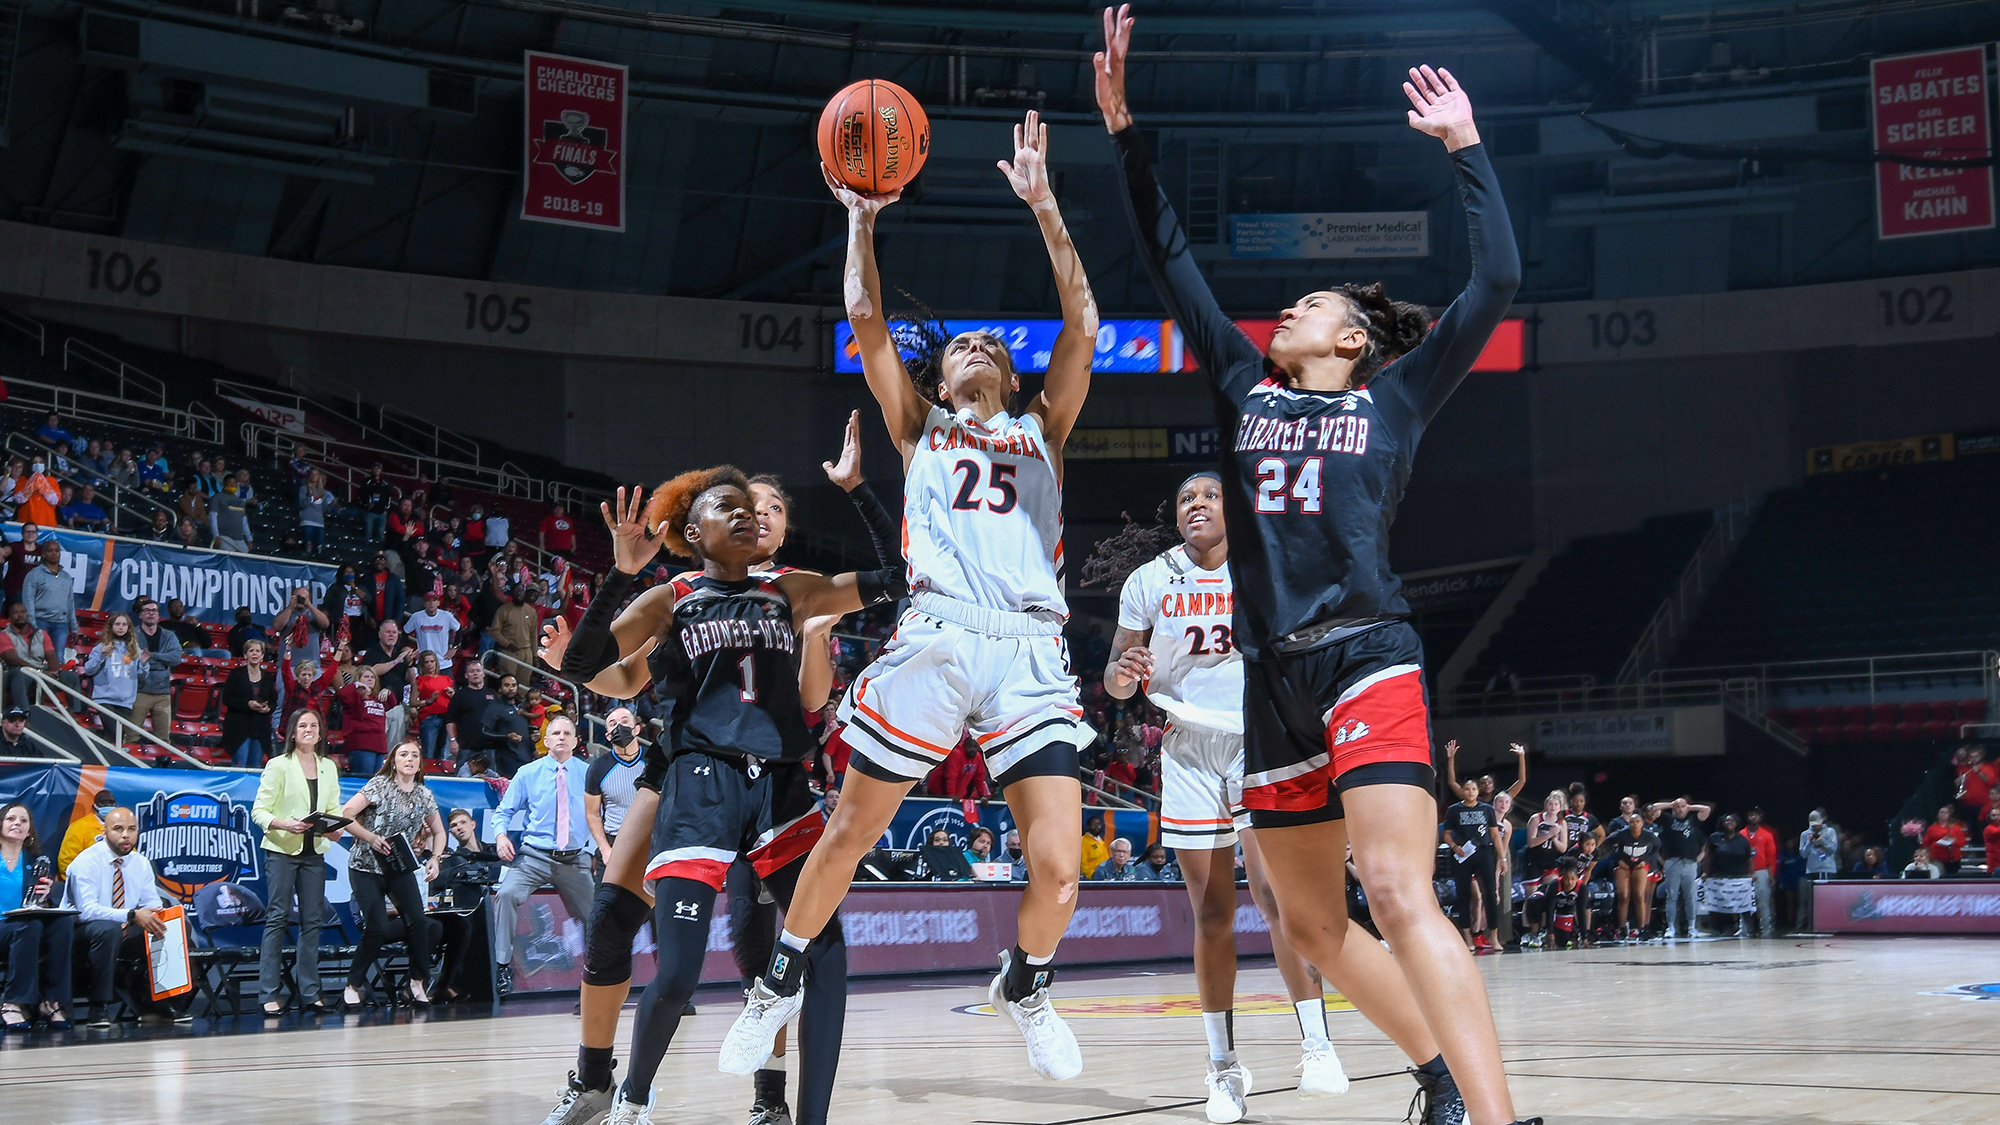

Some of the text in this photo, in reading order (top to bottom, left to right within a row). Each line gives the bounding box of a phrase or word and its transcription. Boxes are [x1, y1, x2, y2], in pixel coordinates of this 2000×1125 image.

[537, 66, 616, 89] CHARLOTTE
[1915, 68, 1943, 78] FELIX
[538, 78, 615, 101] CHECKERS
[1879, 75, 1980, 104] SABATES
[1918, 107, 1943, 118] CARL
[852, 111, 867, 178] LEGACY
[878, 105, 899, 180] SPALDING
[1887, 116, 1976, 143] SCHEER
[553, 144, 597, 165] FINALS
[543, 196, 603, 216] 2018-19
[1913, 186, 1957, 198] MICHAEL
[1904, 196, 1968, 221] KAHN
[1327, 221, 1421, 234] Premier Medical
[1328, 233, 1422, 243] LABORATORY SERVICES
[87, 248, 163, 298] 106
[464, 291, 532, 334] 105
[1878, 285, 1955, 327] 102
[740, 312, 803, 351] 104
[1588, 308, 1657, 348] 103
[245, 406, 295, 426] ARP
[930, 426, 1045, 462] CAMPBELL
[1234, 413, 1369, 456] GARDNER-WEBB
[1841, 449, 1917, 471] CAREER
[952, 458, 1018, 515] 25
[1255, 456, 1323, 514] 24
[120, 557, 333, 616] CHAMPIONSP
[1184, 624, 1235, 655] 23
[737, 653, 758, 703] 1
[137, 825, 250, 865] CHAMPIONSHIPS
[175, 863, 223, 873] HERCULES TIRES
